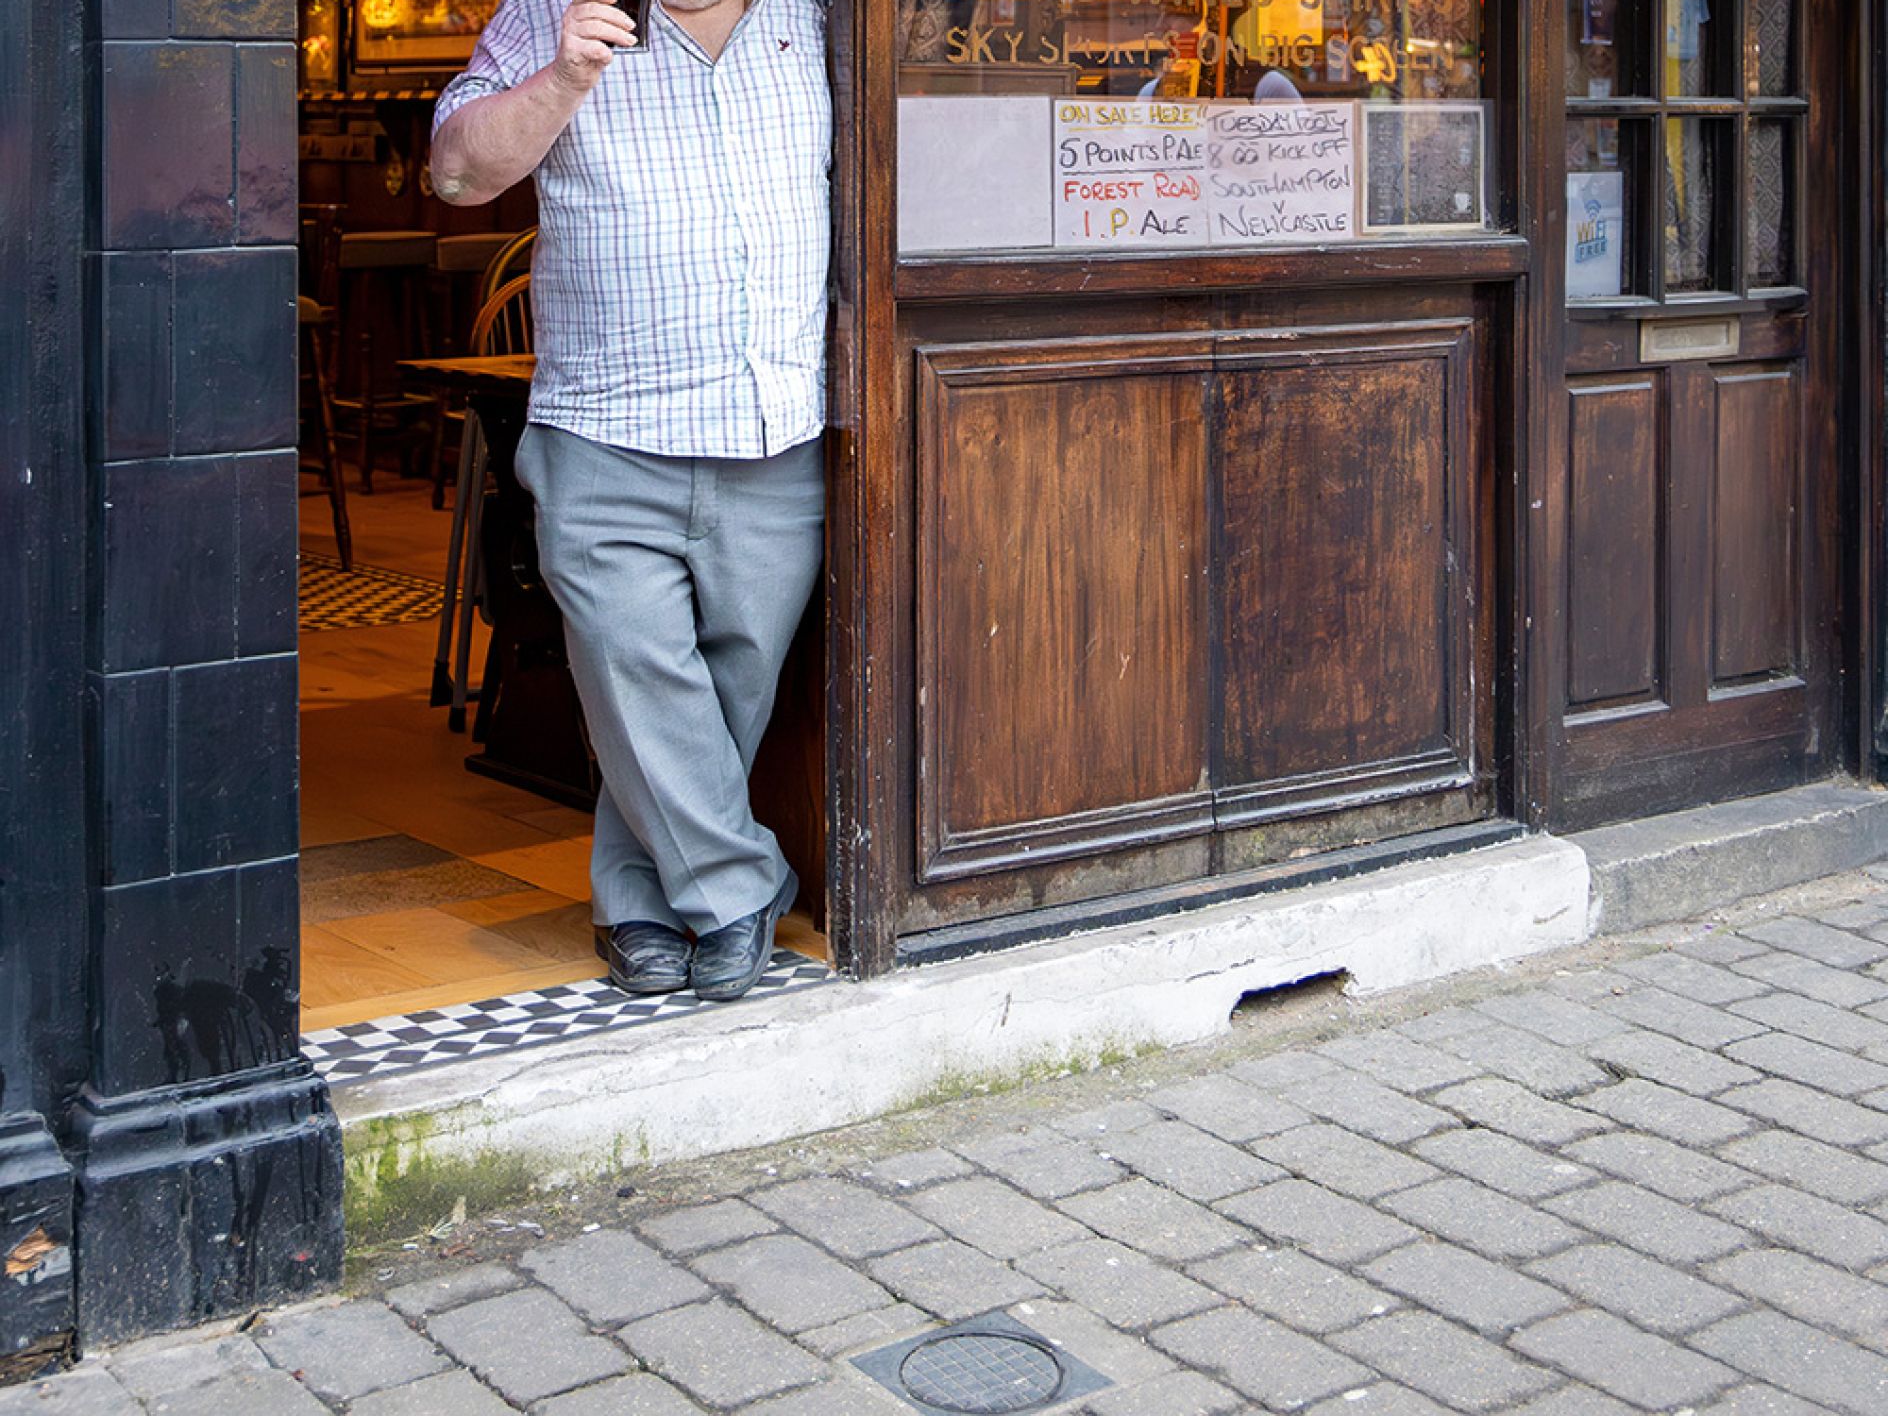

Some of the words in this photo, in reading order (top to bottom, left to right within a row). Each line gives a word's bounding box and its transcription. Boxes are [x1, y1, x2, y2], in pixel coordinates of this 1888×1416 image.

[946, 26, 1024, 64] SKY
[1197, 31, 1245, 67] ON
[1260, 33, 1316, 68] BIG
[1327, 34, 1456, 72] SCEEN
[1059, 104, 1090, 124] ON
[1094, 105, 1145, 125] SALE
[1060, 137, 1081, 168] 5
[1268, 142, 1311, 162] KICK
[1311, 137, 1350, 159] OFF
[1063, 180, 1145, 202] FOREST
[1153, 172, 1201, 201] ROAD
[1209, 164, 1351, 198] SOUTHAMPTON
[1218, 204, 1348, 237] NEWCASTLE
